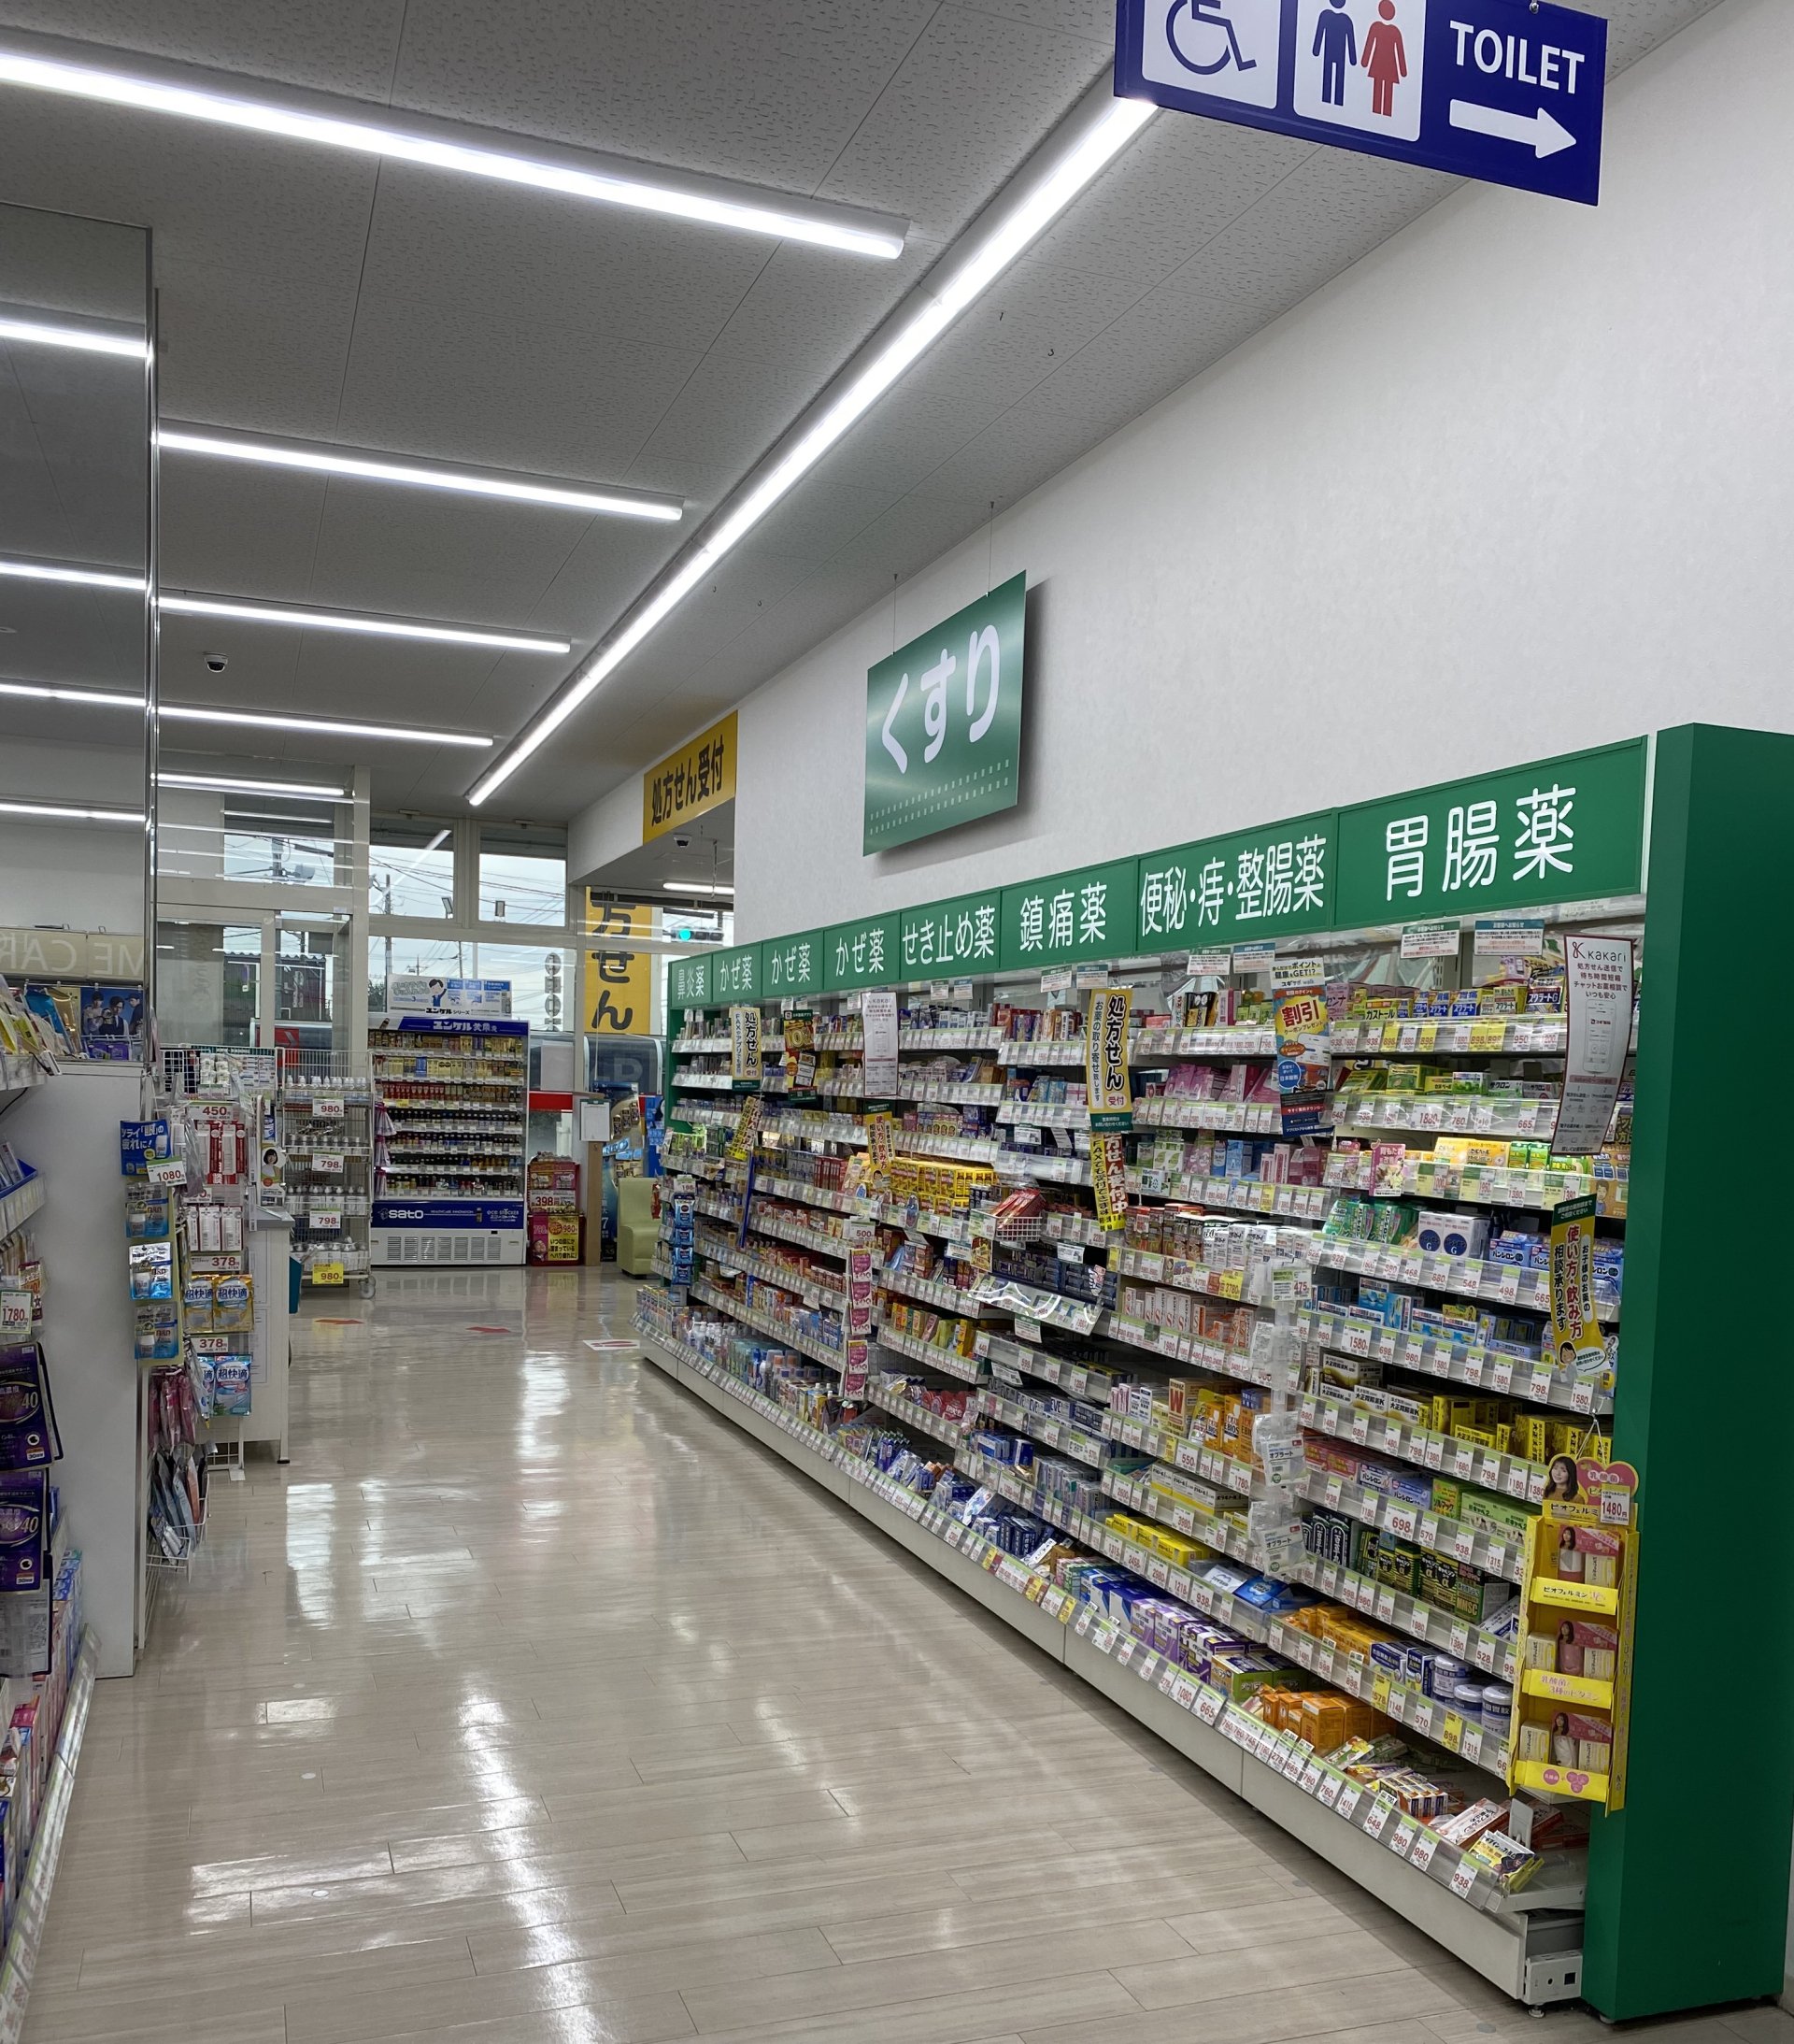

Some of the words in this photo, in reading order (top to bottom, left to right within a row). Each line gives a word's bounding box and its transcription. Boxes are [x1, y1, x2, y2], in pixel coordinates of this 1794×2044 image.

[1450, 21, 1585, 95] TOILET
[882, 624, 1001, 774] くすり
[652, 735, 724, 827] 処方せん受付
[1385, 783, 1576, 901] 胃腸薬
[1140, 834, 1326, 936] 便秘・痔・整腸薬
[1020, 881, 1107, 950] 鎮痛薬
[902, 905, 995, 965] せき止め薬
[836, 928, 884, 976] かぜ薬
[771, 943, 811, 984] かぜ薬
[1577, 963, 1623, 973] 処方せん送信で
[720, 954, 752, 992] かぜ薬
[677, 966, 705, 1001] 鼻炎薬
[1586, 991, 1616, 1000] いつも安心
[1281, 999, 1320, 1027] 割引
[1284, 1021, 1323, 1035] クーポンプレゼント
[745, 1011, 759, 1067] 処方せん
[1105, 994, 1125, 1091] 処方せん
[1107, 1096, 1124, 1107] 受付
[202, 1107, 227, 1116] 450
[157, 1170, 181, 1182] 1080
[1103, 1132, 1129, 1214] 方せん受付中
[388, 1209, 424, 1220] sato
[211, 1257, 235, 1266] 378
[1553, 1244, 1566, 1332] 相談承ります
[1565, 1224, 1584, 1339] 使い方・飲み方
[217, 1288, 248, 1299] 超快適
[1499, 1285, 1515, 1296] 498
[199, 1338, 224, 1348] 378
[1350, 1335, 1367, 1350] 1580
[217, 1368, 249, 1380] 超快適
[1465, 1366, 1480, 1378] 798
[1531, 1383, 1547, 1395] 798
[1573, 1393, 1588, 1406] 1580
[1269, 1450, 1294, 1460] オブラート
[1410, 1446, 1424, 1456] 798
[1483, 1469, 1497, 1481] 798
[1509, 1478, 1525, 1490] 1180
[1392, 1516, 1412, 1533] 698
[1420, 1530, 1434, 1541] 570
[1456, 1542, 1471, 1556] 938
[1196, 1592, 1211, 1608] 938
[1544, 1586, 1588, 1598] ビオフェルミン
[1457, 1598, 1478, 1615] MMSC
[1477, 1651, 1491, 1664] 528
[1200, 1701, 1216, 1719] 665
[1416, 1714, 1430, 1728] 570
[1303, 1771, 1317, 1787] 760
[1319, 1784, 1334, 1800] 760
[1366, 1814, 1382, 1831] 648
[1392, 1832, 1408, 1849] 980
[1414, 1847, 1430, 1864] 980
[1453, 1873, 1470, 1890] 938
